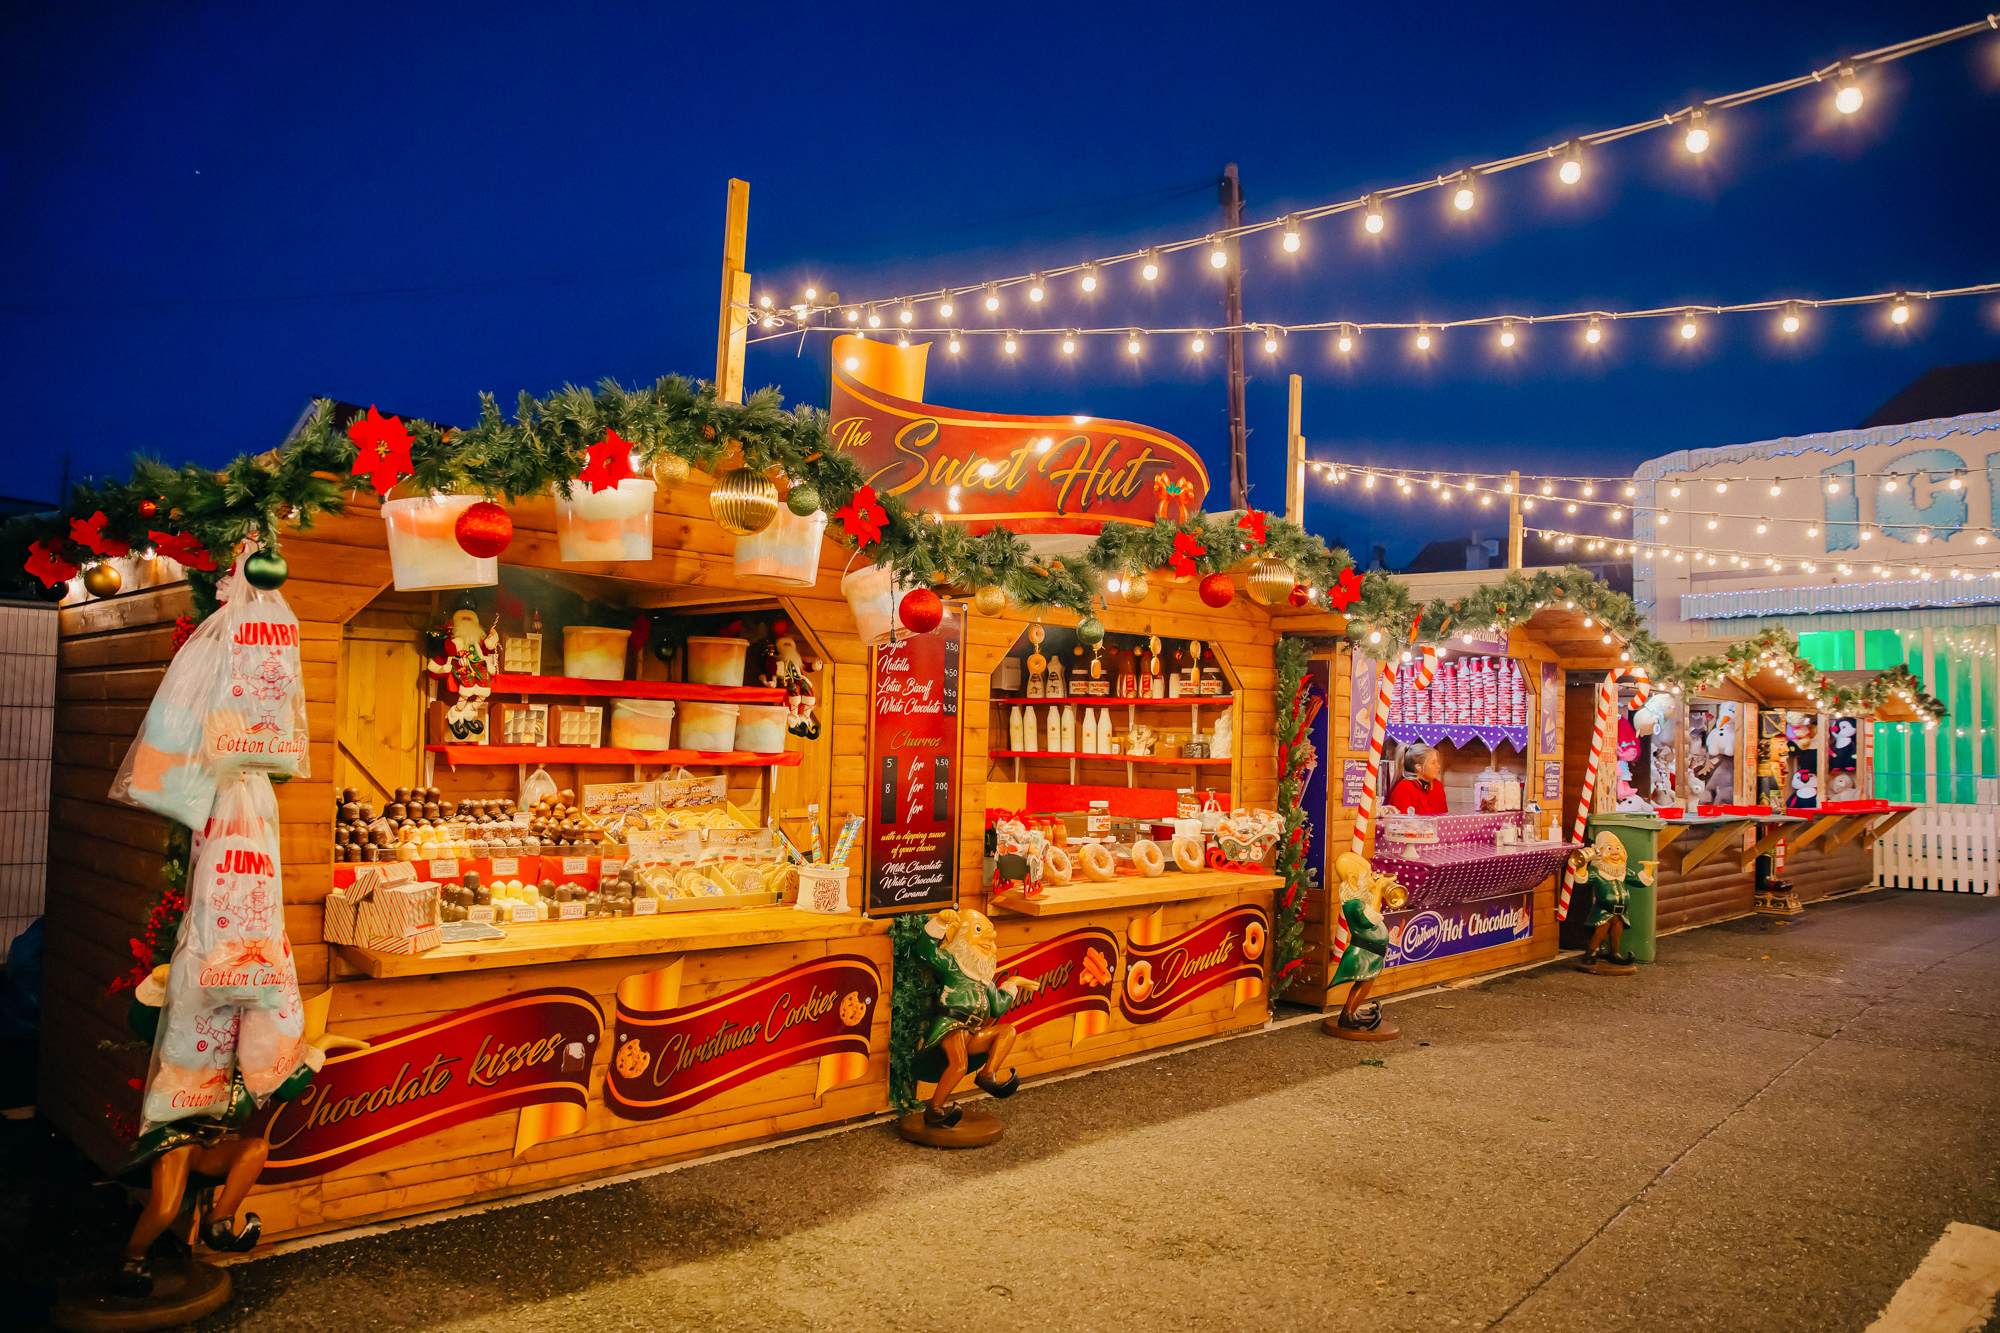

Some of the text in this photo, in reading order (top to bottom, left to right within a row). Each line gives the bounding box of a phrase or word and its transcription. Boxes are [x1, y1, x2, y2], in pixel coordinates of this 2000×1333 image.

[832, 417, 1173, 515] The Sweet Hut
[878, 654, 910, 674] Nutella
[877, 676, 902, 696] Lotus
[902, 677, 933, 701] Biscoff
[877, 696, 905, 714] White
[904, 698, 942, 715] Chocolate
[217, 734, 307, 760] Cotton Candy
[891, 729, 942, 751] Churros
[886, 758, 893, 768] 5
[908, 755, 924, 780] for
[618, 791, 654, 800] COMPANY
[663, 784, 725, 796] COOKIE COMPANY
[885, 783, 891, 794] 8
[907, 777, 924, 802] for
[906, 799, 923, 824] for
[881, 830, 896, 841] with
[902, 830, 927, 844] dipping
[916, 842, 936, 852] choice
[565, 863, 585, 872] ORANGE
[881, 859, 943, 875] Milk Chocolate
[879, 873, 945, 889] White Chocolate
[895, 886, 931, 901] Caramel
[471, 912, 493, 921] CARAMEL
[562, 907, 583, 917] BAILEYS
[1404, 908, 1520, 953] Cadbury Hot Chocolate
[1151, 931, 1240, 999] Donuts
[200, 966, 287, 993] Cotton Candy
[653, 985, 839, 1087] Christmas Cookies
[171, 1090, 213, 1108] Cotton
[263, 1033, 566, 1149] Chocolate kisses
